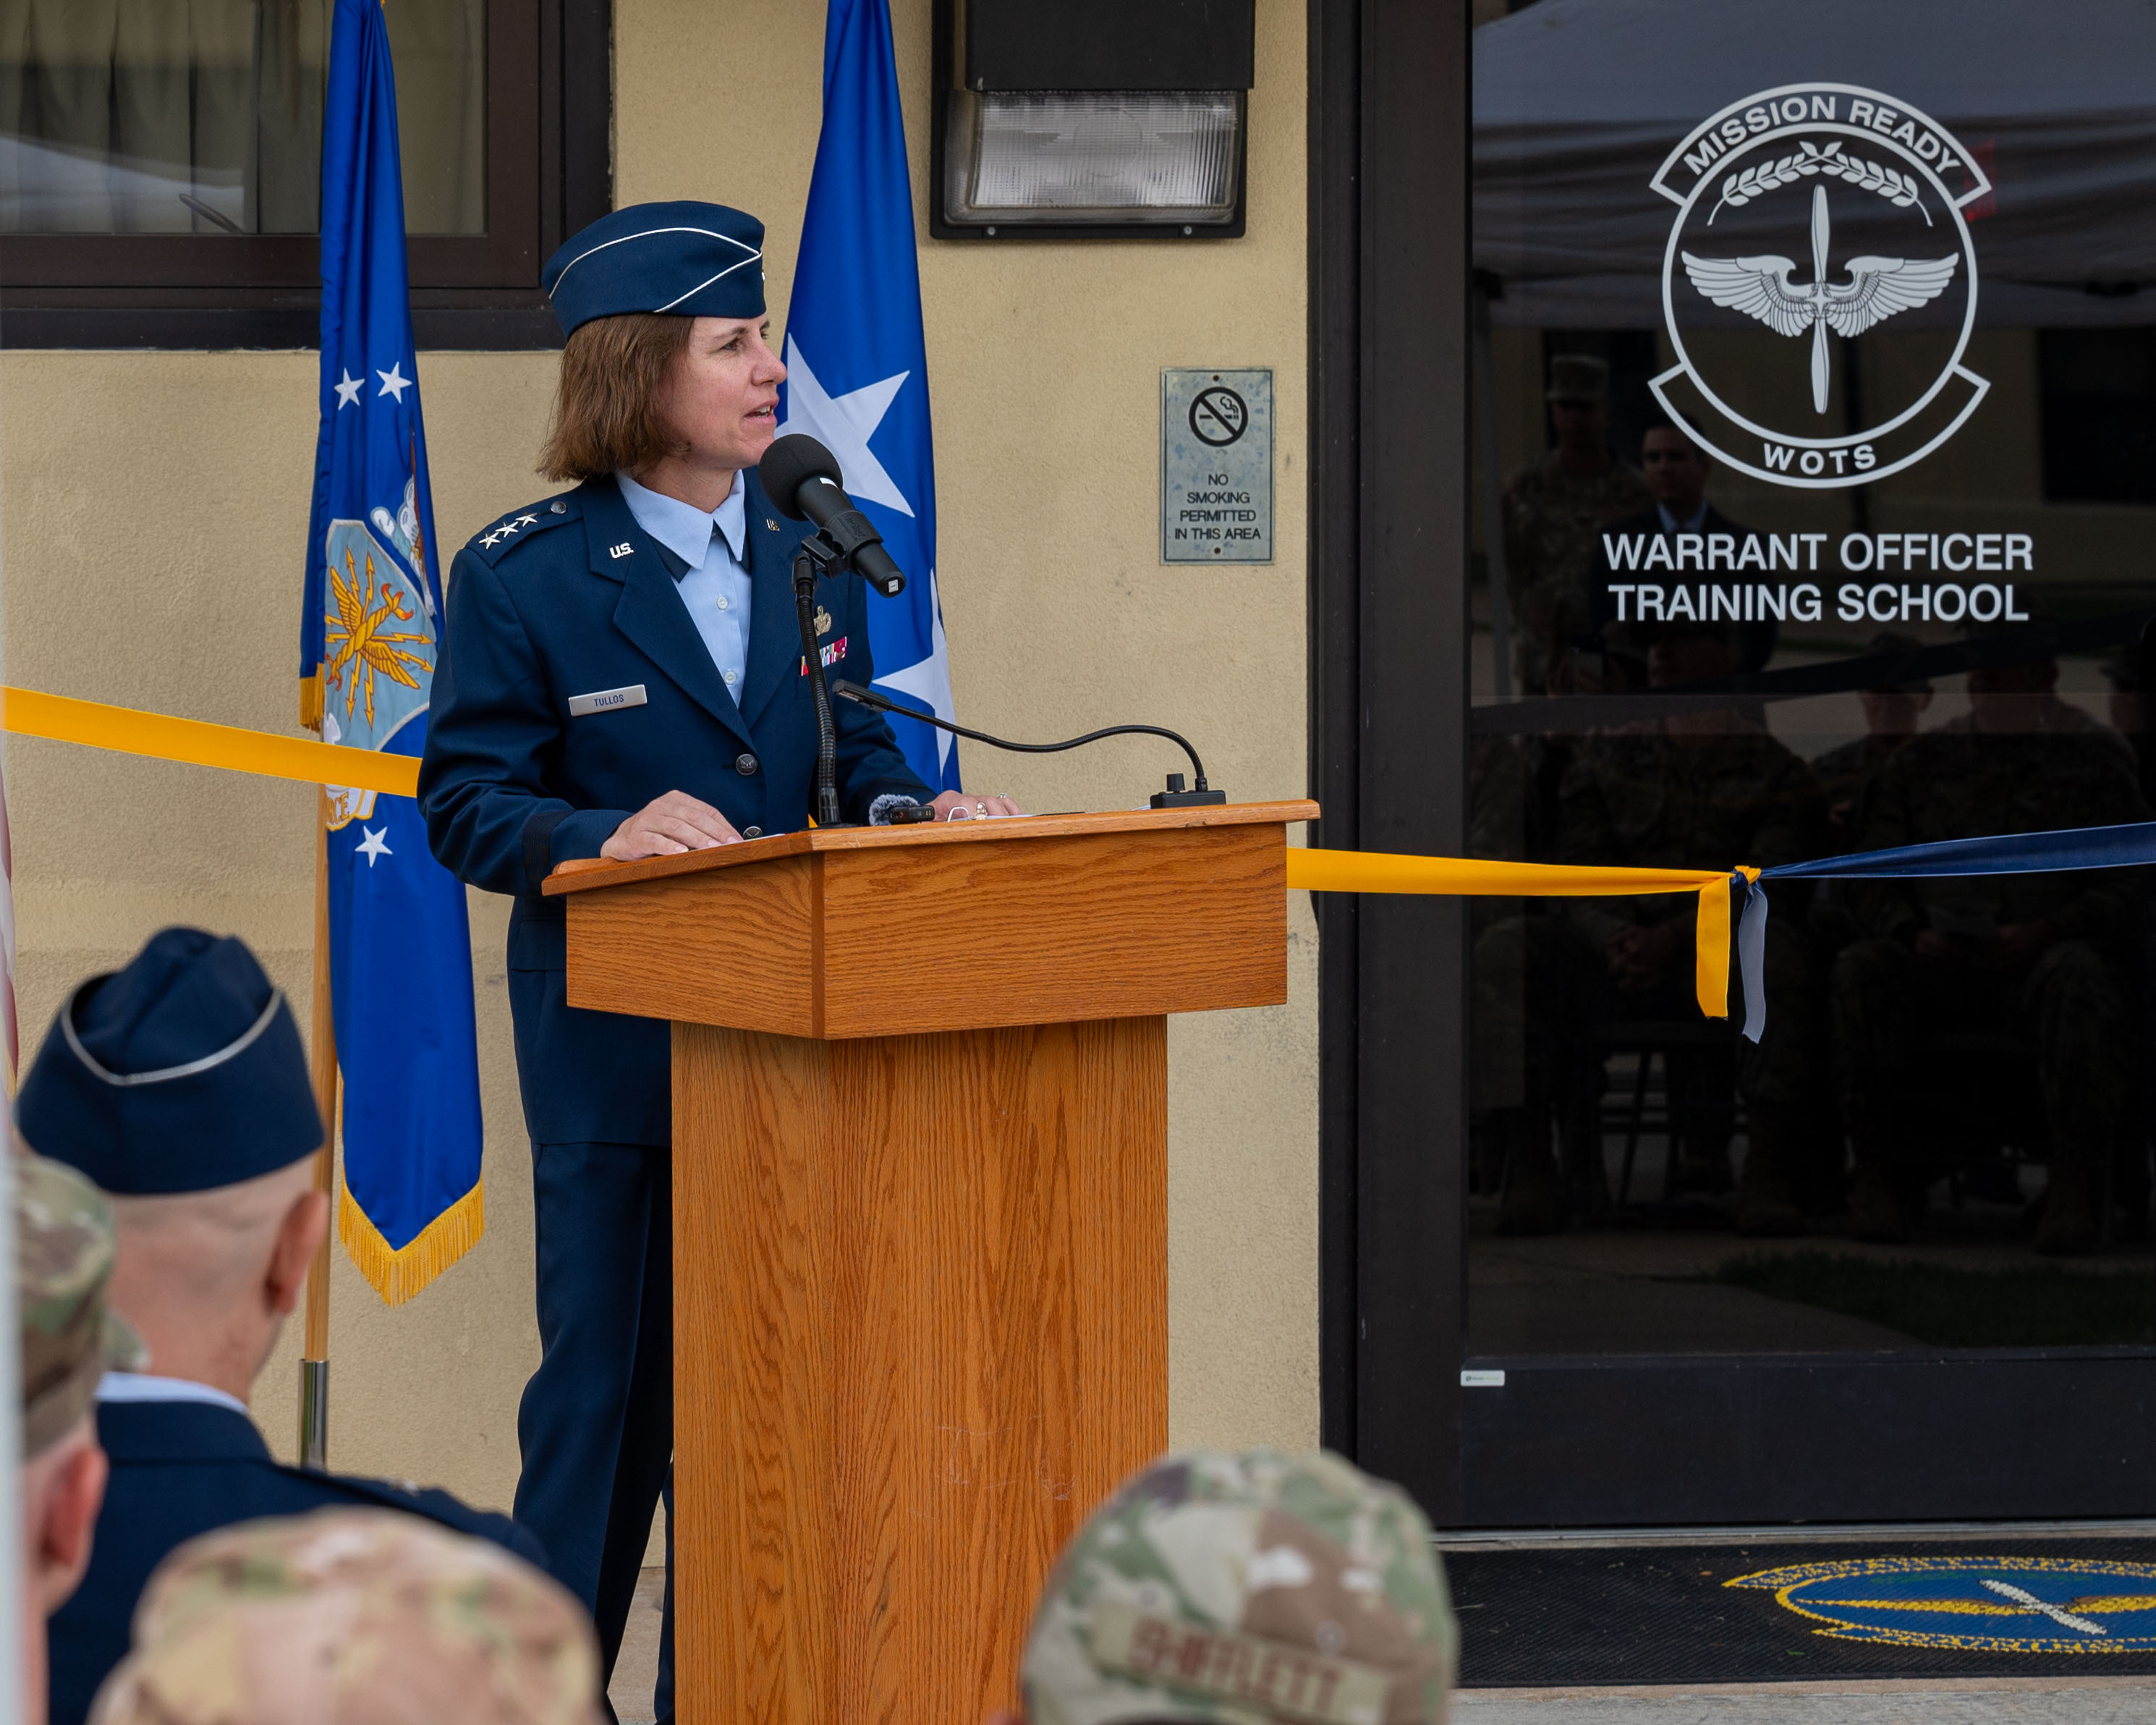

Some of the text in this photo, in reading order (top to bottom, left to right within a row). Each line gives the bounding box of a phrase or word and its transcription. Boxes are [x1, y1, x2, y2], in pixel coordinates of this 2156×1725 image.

[1683, 96, 1961, 176] MISSION READY
[1763, 444, 1876, 475] WOTS
[1208, 473, 1228, 486] NO
[1187, 492, 1250, 504] SMOKING
[1180, 509, 1256, 522] PERMITTED
[1175, 527, 1261, 540] IN THIS AREA
[1603, 533, 2034, 570] WARRANT OFFICER
[1608, 584, 2029, 622] TRAINING SCHOOL
[594, 694, 624, 707] TULLOS
